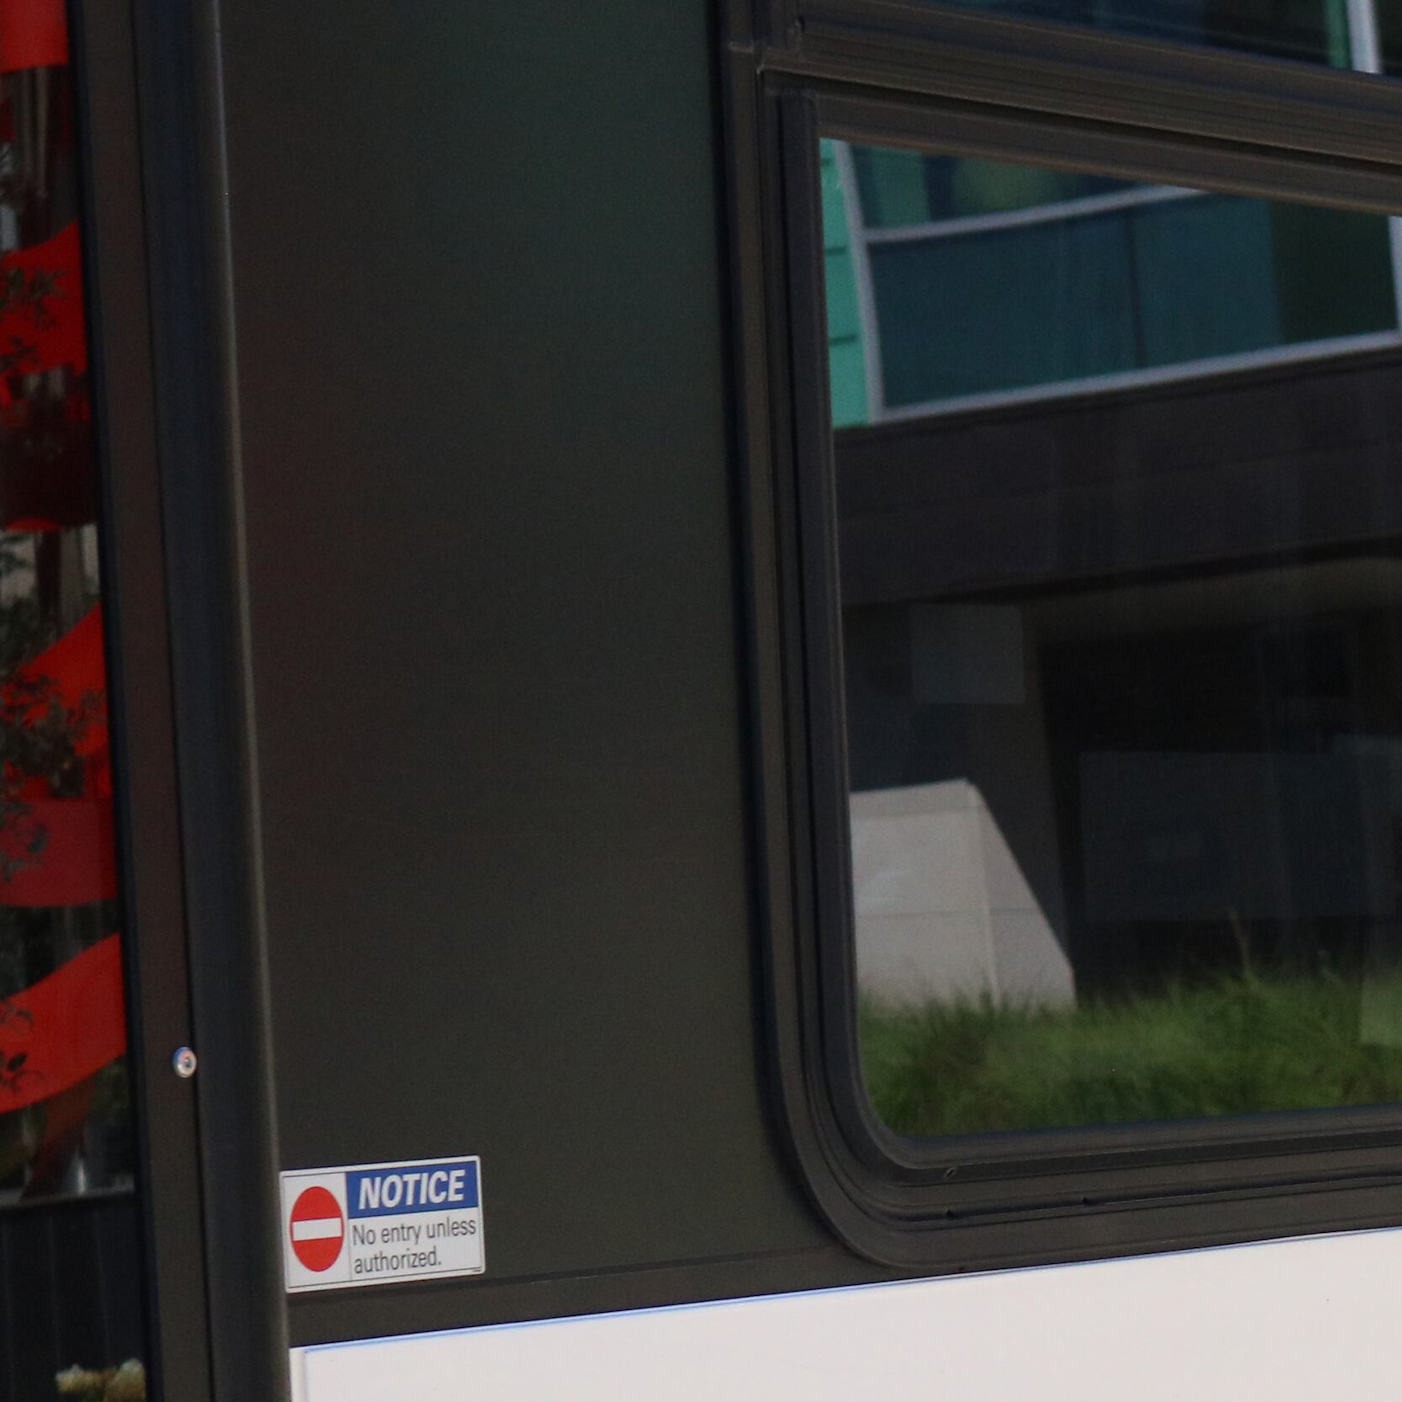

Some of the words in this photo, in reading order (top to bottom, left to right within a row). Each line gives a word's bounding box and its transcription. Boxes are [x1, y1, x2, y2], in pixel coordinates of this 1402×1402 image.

[358, 1169, 466, 1210] NOTICE
[352, 1224, 376, 1246] No
[382, 1222, 422, 1246] entry
[426, 1217, 477, 1239] unless
[354, 1246, 442, 1275] authorized.
